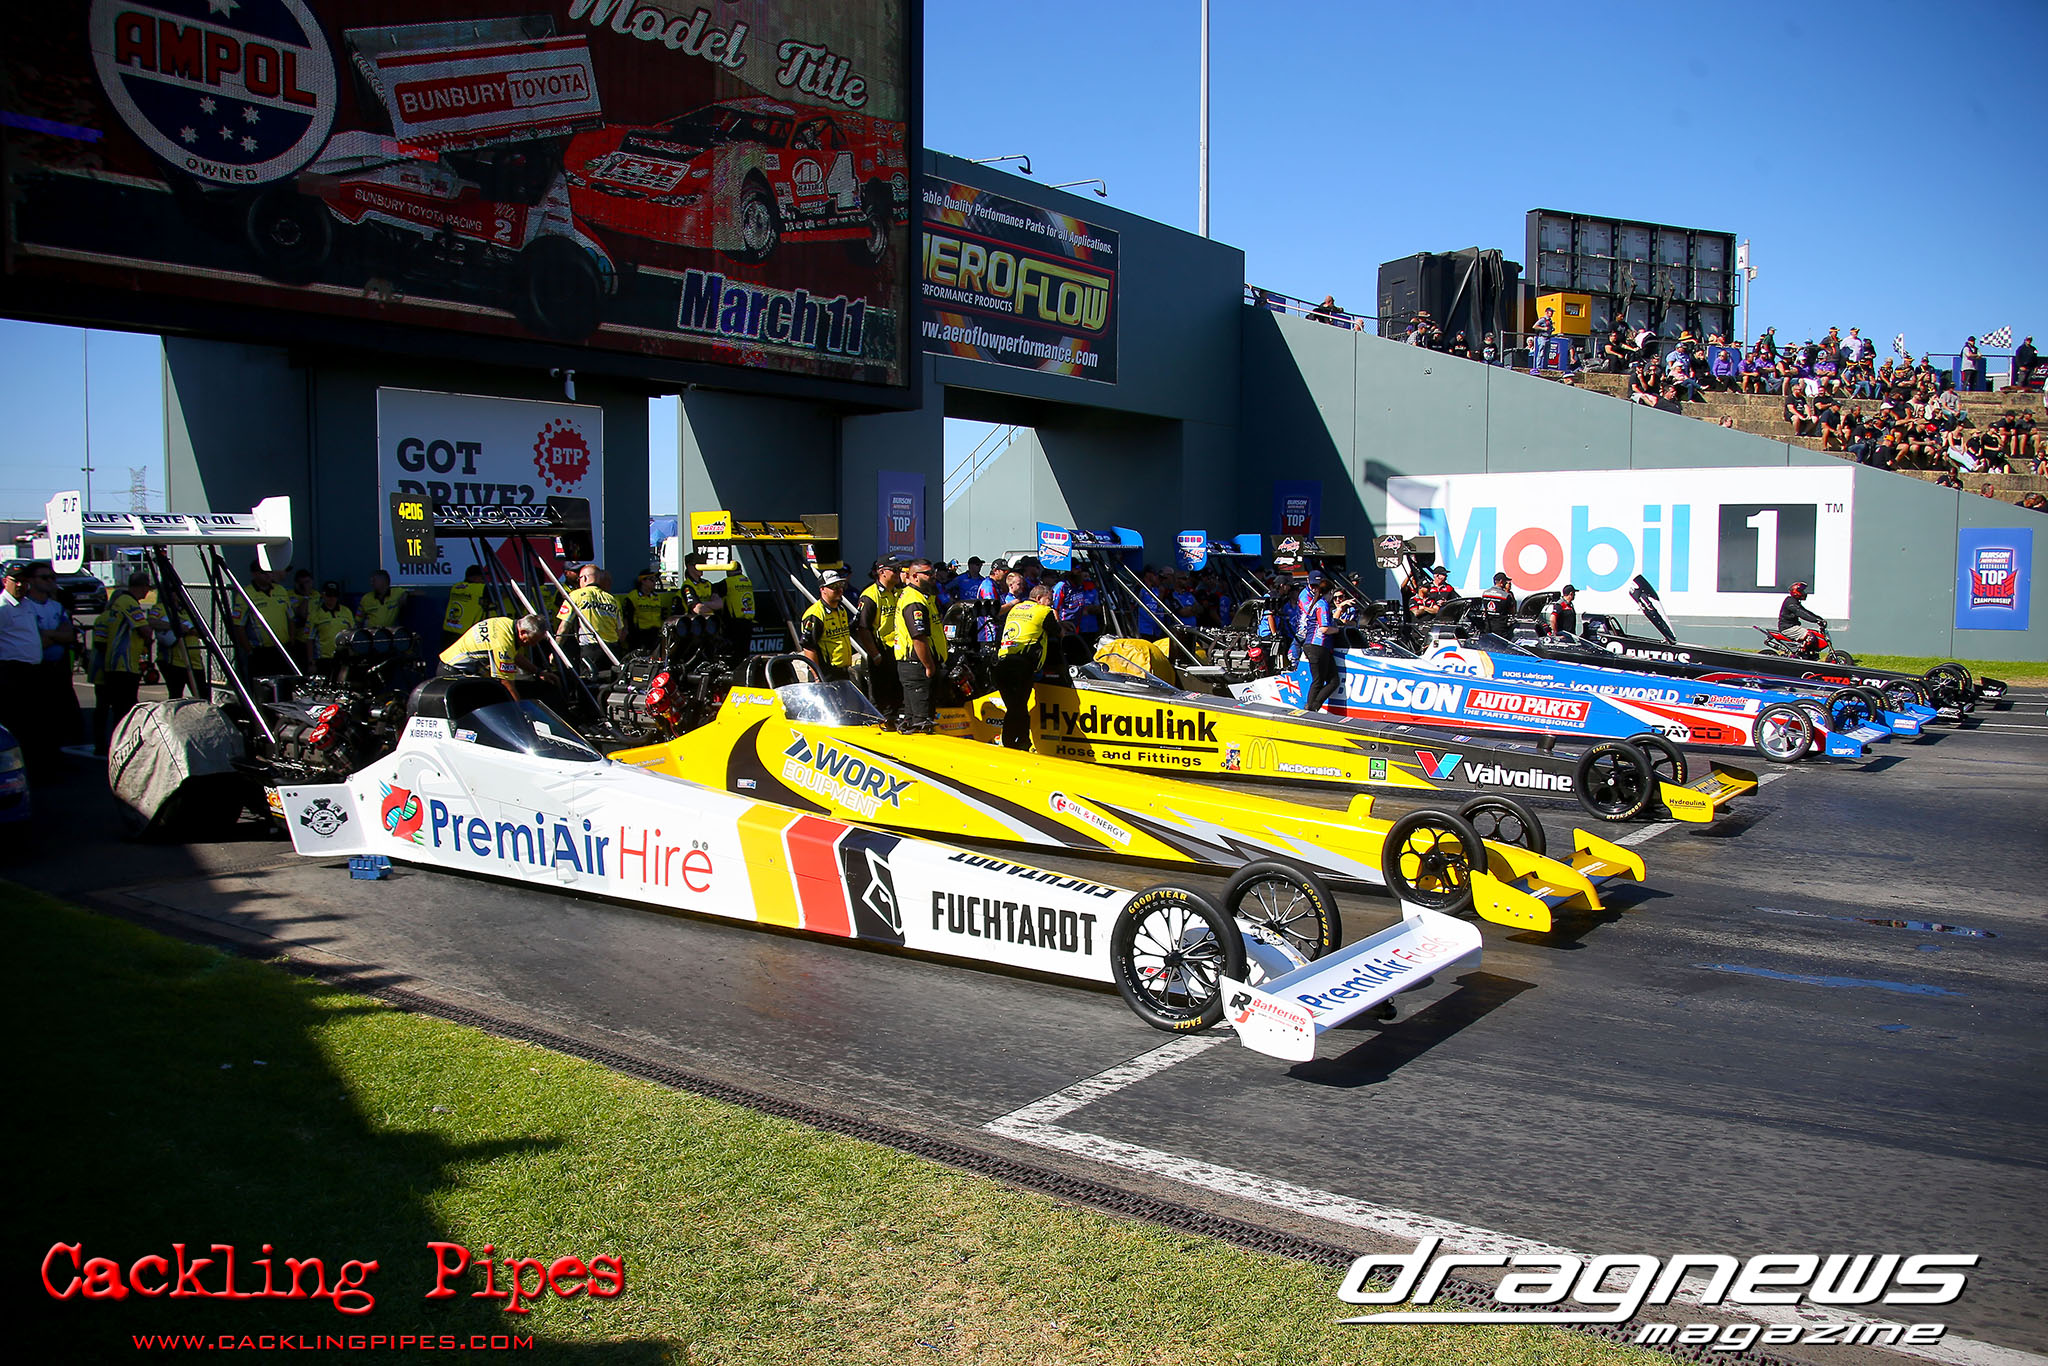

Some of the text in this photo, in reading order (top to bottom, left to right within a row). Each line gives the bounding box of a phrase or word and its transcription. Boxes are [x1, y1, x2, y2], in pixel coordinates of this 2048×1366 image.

[114, 11, 317, 108] AMPOL
[567, 0, 869, 108] Model Title
[401, 73, 586, 114] BUNBURY TOYOTA
[185, 156, 258, 182] OWNED
[354, 188, 483, 232] BUNBURY TOYOTA RACING
[922, 189, 1114, 255] able Quality Performance Parts for all Applications.
[494, 218, 513, 242] 2
[677, 269, 868, 355] March 11
[974, 294, 1013, 313] PRODUCTS
[396, 437, 482, 475] GOT
[552, 447, 584, 465] BTP
[82, 513, 119, 524] ULF
[211, 514, 241, 525] OIL
[398, 502, 424, 521] 4206
[893, 516, 910, 532] TOP
[1286, 514, 1305, 527] TOP
[55, 533, 80, 561] 3698
[706, 546, 729, 565] 33
[1418, 503, 1844, 593] Mobil 1 TM
[400, 562, 452, 576] HIRING
[1979, 569, 2008, 586] TOP
[1978, 585, 2009, 598] FUEL
[1238, 694, 1262, 703] FUCHS
[1338, 671, 1464, 714] BURSON
[1473, 691, 1583, 720] AUTO PARTS
[1616, 686, 1681, 704] WORLD
[415, 718, 438, 728] PETER
[1040, 703, 1218, 743] Hydraulink
[1463, 708, 1585, 729] THE PARTS PROFESSIONALS
[1650, 724, 1722, 740] DAYCO
[1055, 743, 1202, 768] Hose and Fittings
[814, 740, 911, 809] WORX
[1278, 762, 1342, 778] McDonald's
[1464, 761, 1574, 792] Valvoline
[781, 758, 881, 819] EQUIPMENT
[1669, 798, 1707, 807] Hydraulink
[1068, 802, 1126, 839] OIL & ENERGY
[430, 799, 713, 893] PremiAir Hire
[1128, 890, 1188, 915] GOODYEAR
[1302, 882, 1331, 947] GOODYEAR
[932, 890, 1098, 956] FUCHTARDT
[1296, 935, 1460, 1011] PremiAir Fuels
[1173, 1015, 1203, 1030] EAGLE
[1252, 998, 1307, 1026] Batteries
